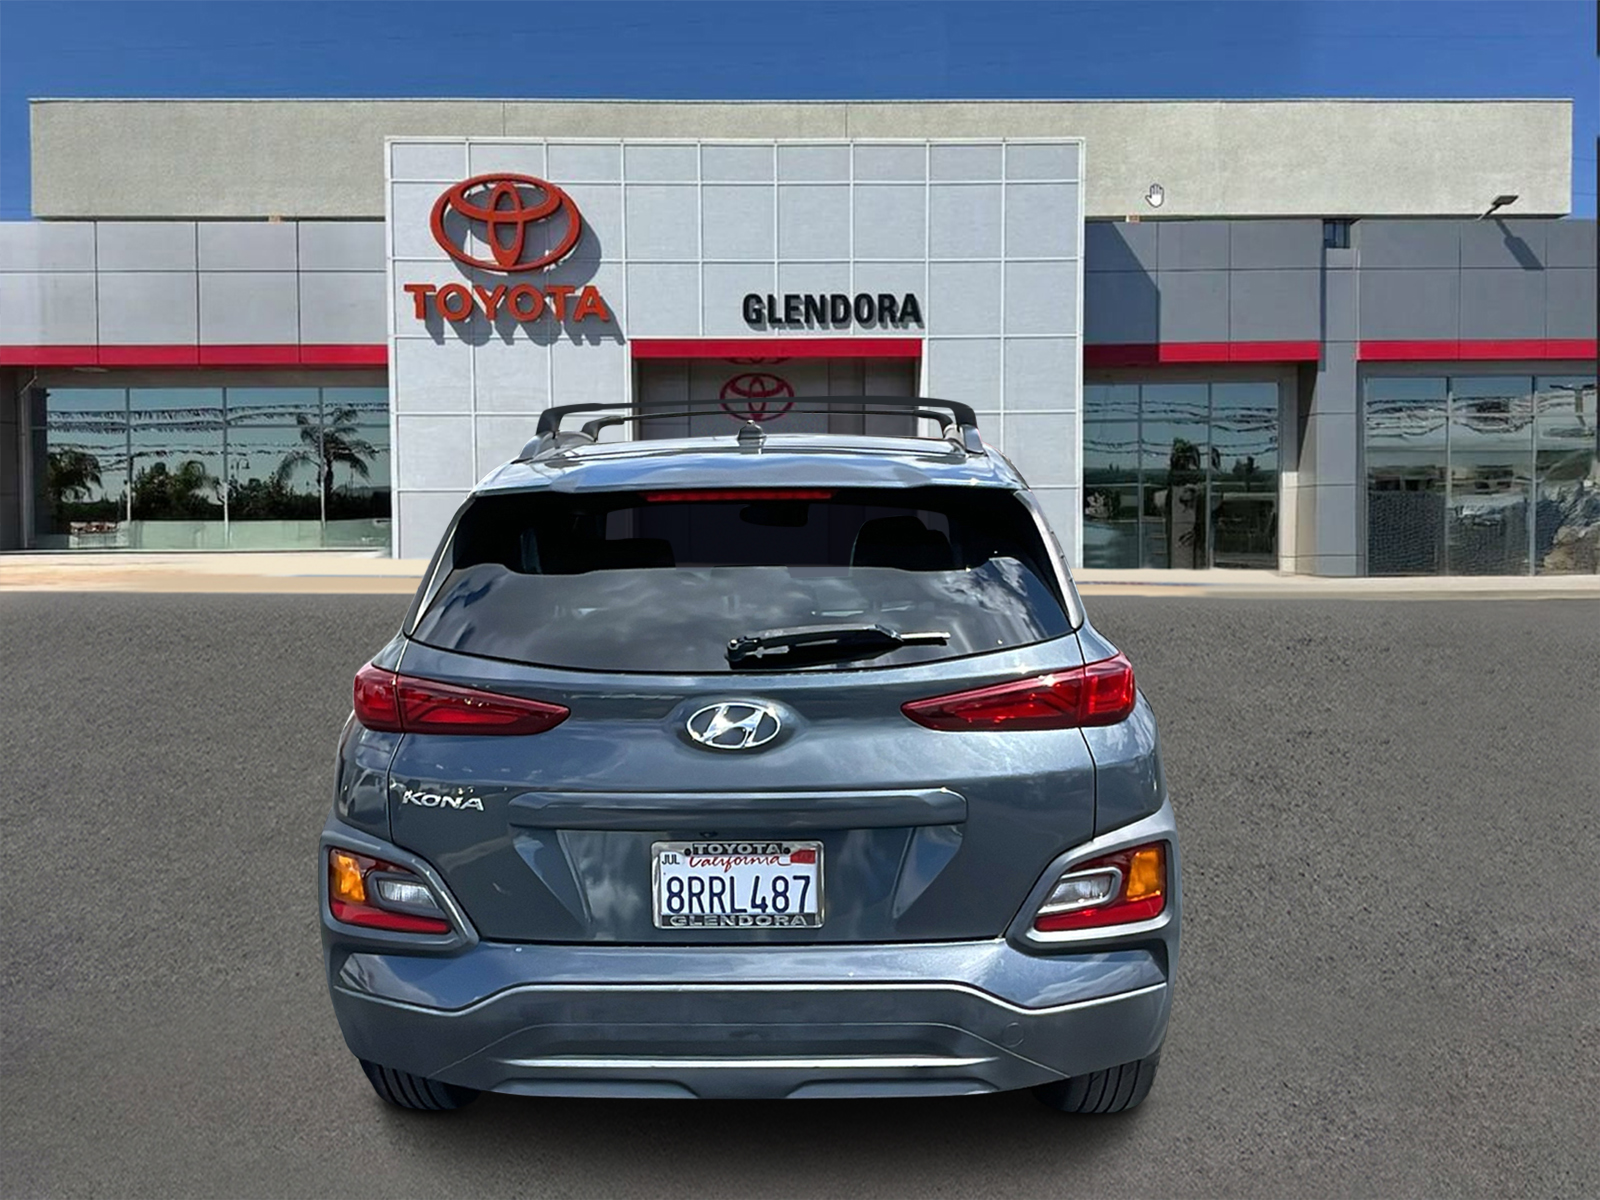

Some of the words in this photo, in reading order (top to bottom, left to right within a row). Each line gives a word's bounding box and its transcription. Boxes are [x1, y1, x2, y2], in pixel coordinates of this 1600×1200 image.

[404, 283, 609, 323] TOYOTA
[743, 293, 922, 325] GLENDORA
[402, 790, 484, 811] KONA
[693, 844, 781, 854] TOYOTA
[661, 854, 680, 865] JUL
[689, 855, 791, 873] California
[666, 876, 811, 914] 8RRL487
[670, 915, 807, 926] GLENDORA
